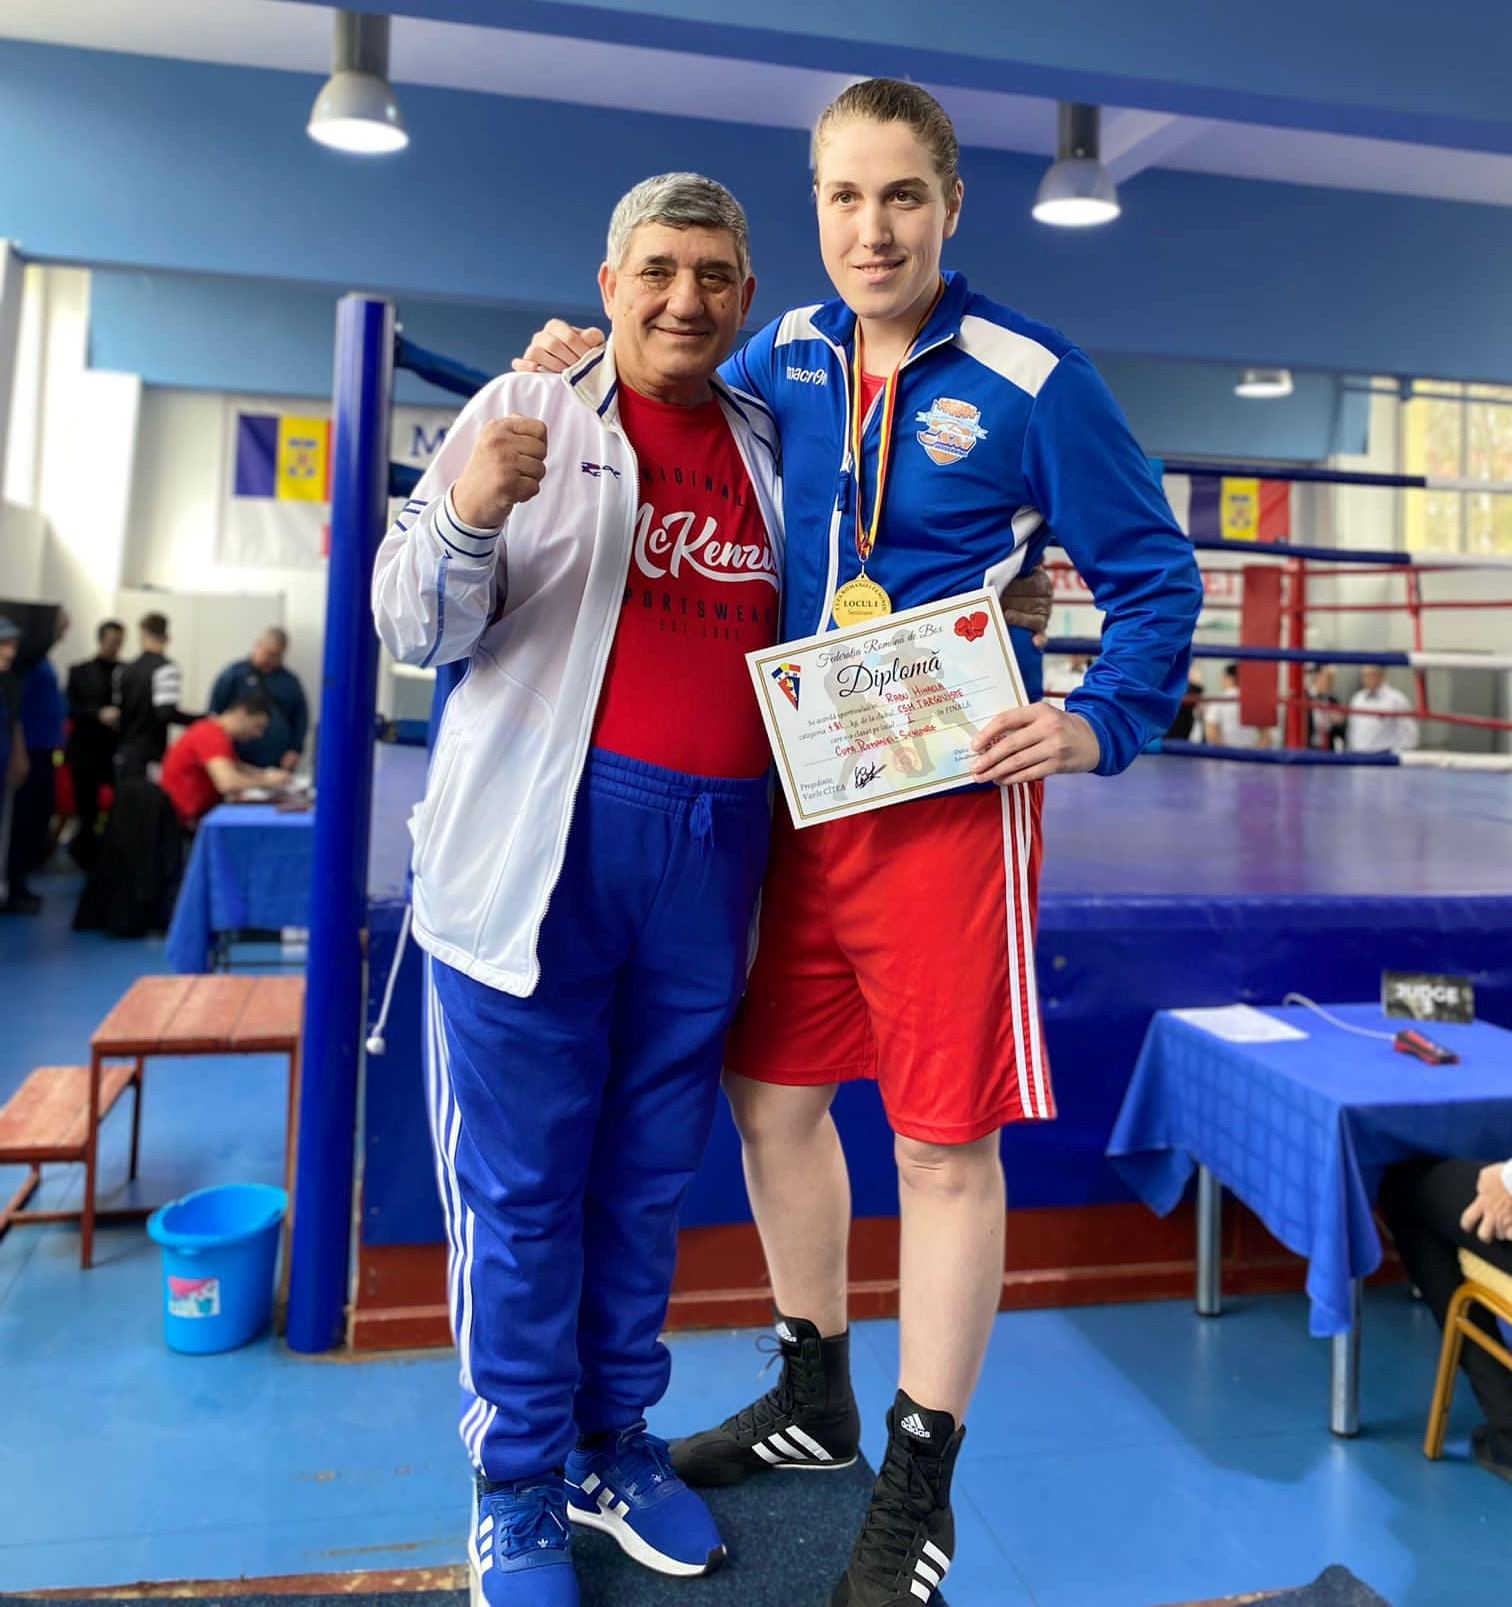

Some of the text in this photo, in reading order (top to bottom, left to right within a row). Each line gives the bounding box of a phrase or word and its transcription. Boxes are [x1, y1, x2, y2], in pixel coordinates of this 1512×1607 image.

[786, 366, 828, 387] macron
[634, 502, 780, 592] McKenzi
[843, 600, 873, 608] LOCUL
[907, 630, 917, 640] de
[919, 623, 943, 639] Box
[837, 650, 942, 698] Diplomă
[884, 692, 909, 704] RADU
[897, 702, 915, 714] CSM
[834, 745, 857, 757] CUPA
[900, 1419, 931, 1439] adidas
